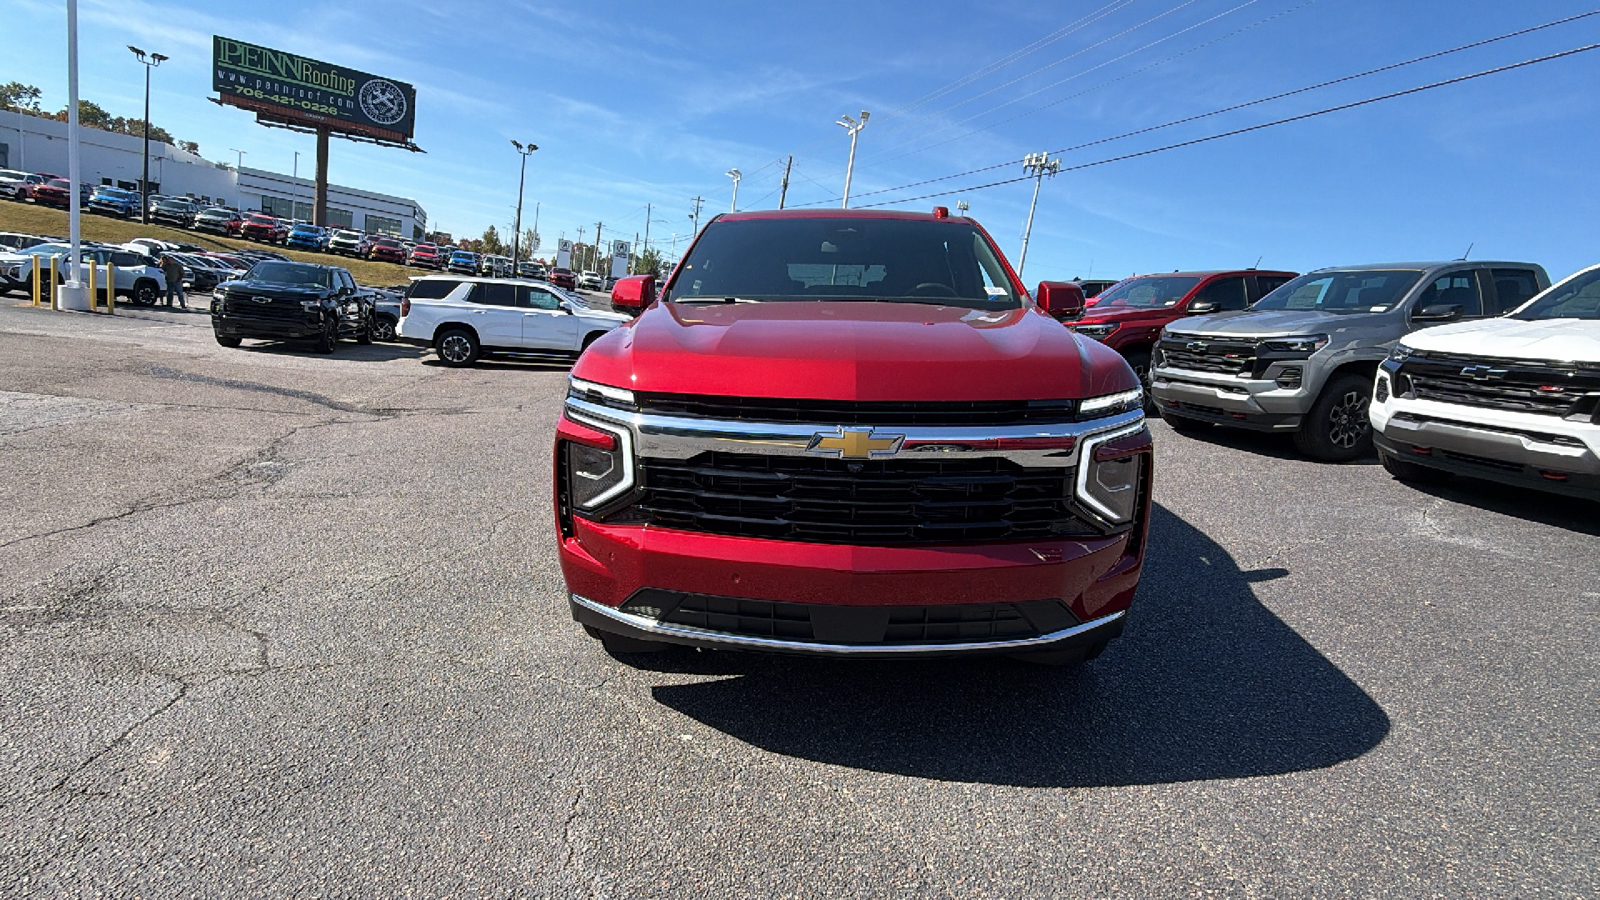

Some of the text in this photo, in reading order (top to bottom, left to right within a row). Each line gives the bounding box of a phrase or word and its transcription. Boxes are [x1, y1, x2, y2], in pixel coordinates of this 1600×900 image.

[218, 38, 356, 97] PENN Roofing
[234, 84, 338, 116] 706-421-0226
